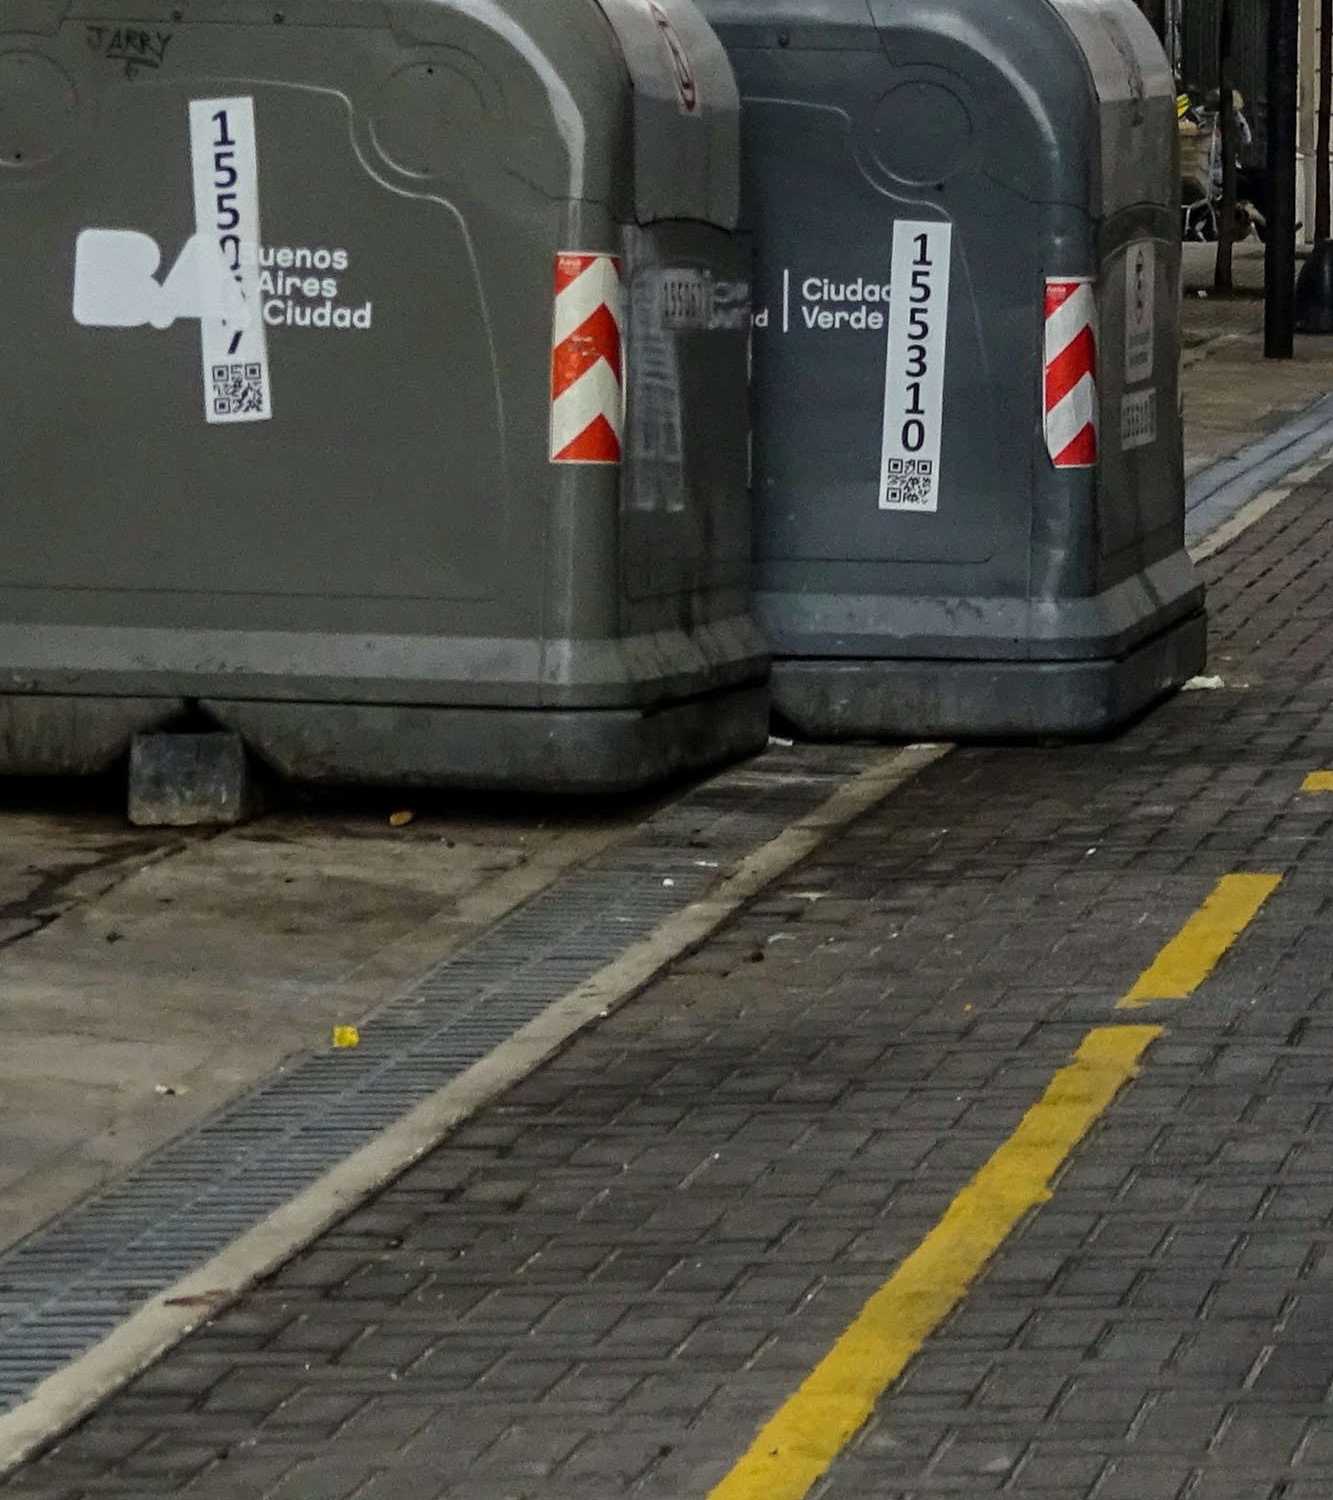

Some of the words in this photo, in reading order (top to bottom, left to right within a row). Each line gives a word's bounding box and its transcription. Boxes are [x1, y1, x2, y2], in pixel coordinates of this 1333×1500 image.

[259, 247, 348, 270] uenos
[262, 301, 372, 329] Ciudad
[801, 305, 884, 330] Verde
[901, 232, 933, 453] 155310
